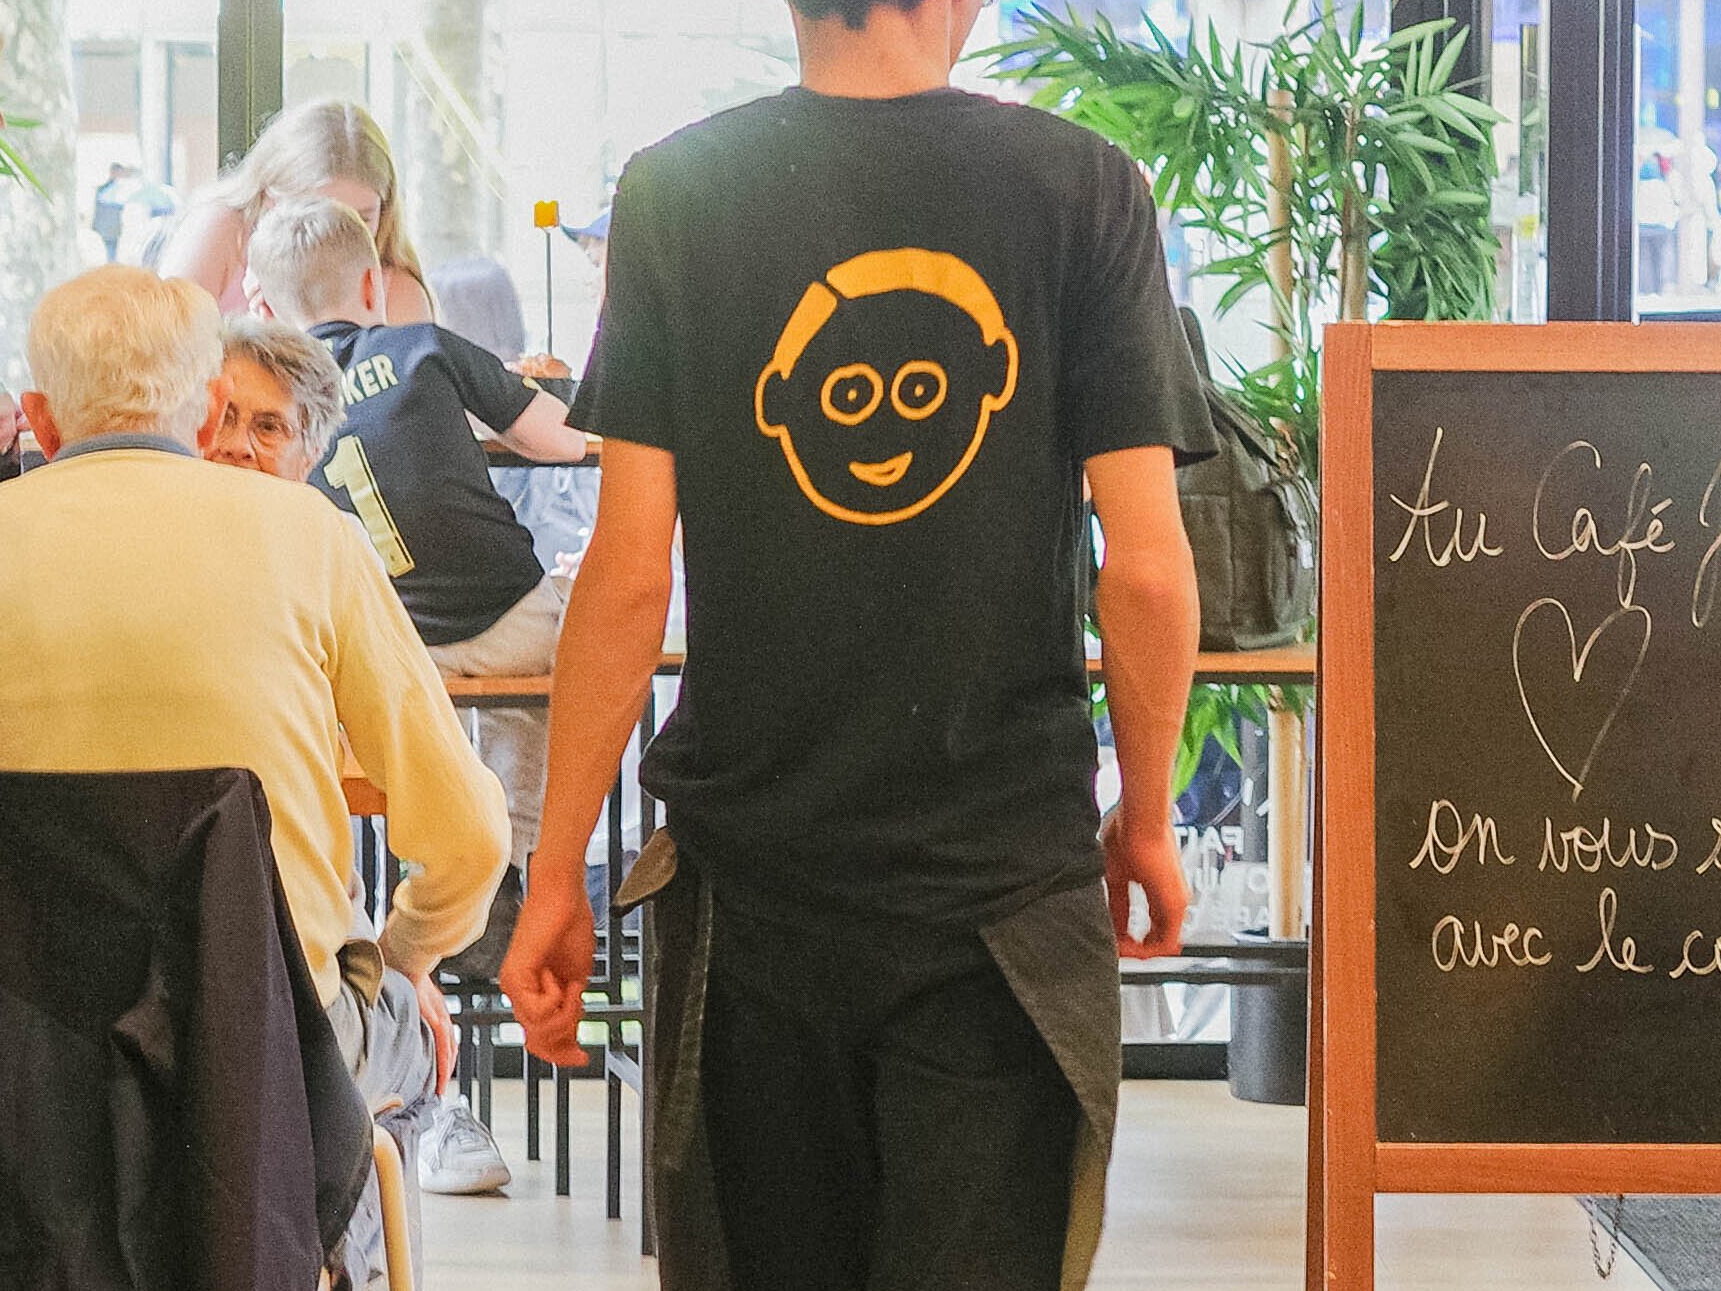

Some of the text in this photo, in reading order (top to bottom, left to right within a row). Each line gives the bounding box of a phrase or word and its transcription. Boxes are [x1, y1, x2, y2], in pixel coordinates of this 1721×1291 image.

[1532, 440, 1675, 608] Café
[1538, 815, 1679, 873] vous
[1431, 914, 1553, 972] avec
[1575, 886, 1655, 973] le
